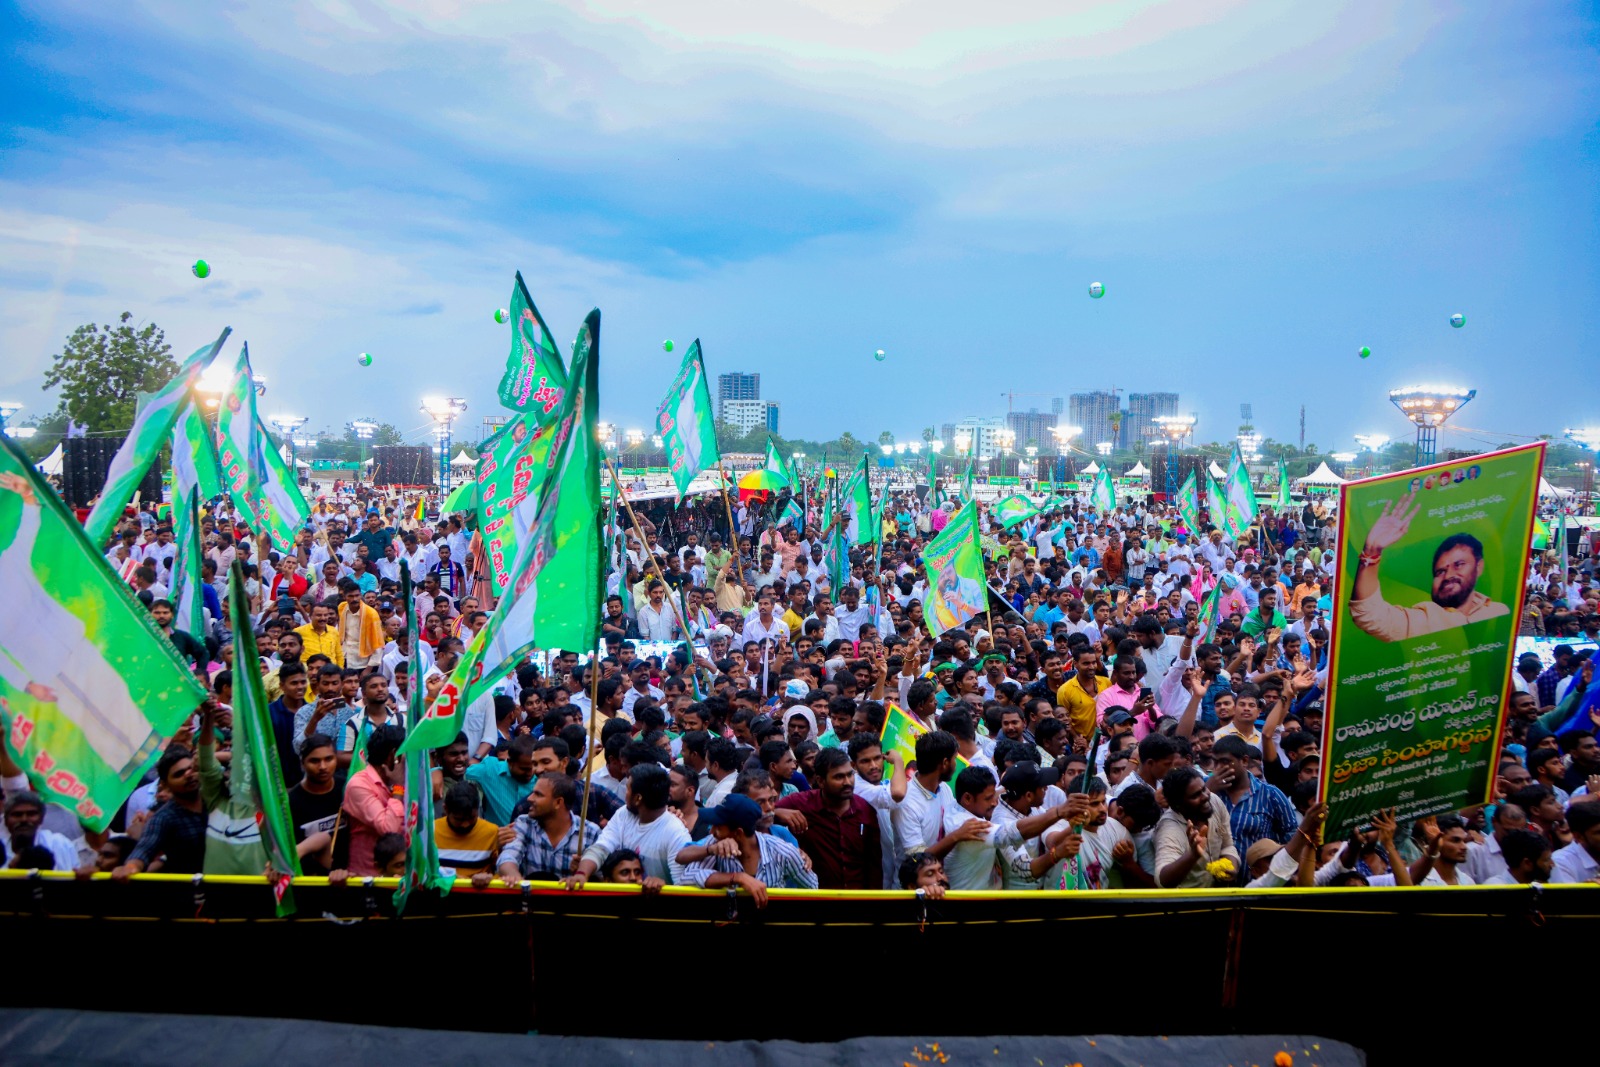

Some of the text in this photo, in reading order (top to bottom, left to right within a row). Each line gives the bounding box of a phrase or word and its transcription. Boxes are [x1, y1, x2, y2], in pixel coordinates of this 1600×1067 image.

[1335, 708, 1416, 742] రామచంద్ర
[1418, 690, 1477, 721] యాదవ్
[1332, 725, 1492, 784] ప్రజా సింహగర్జన
[1338, 780, 1385, 801] 23-07-2023
